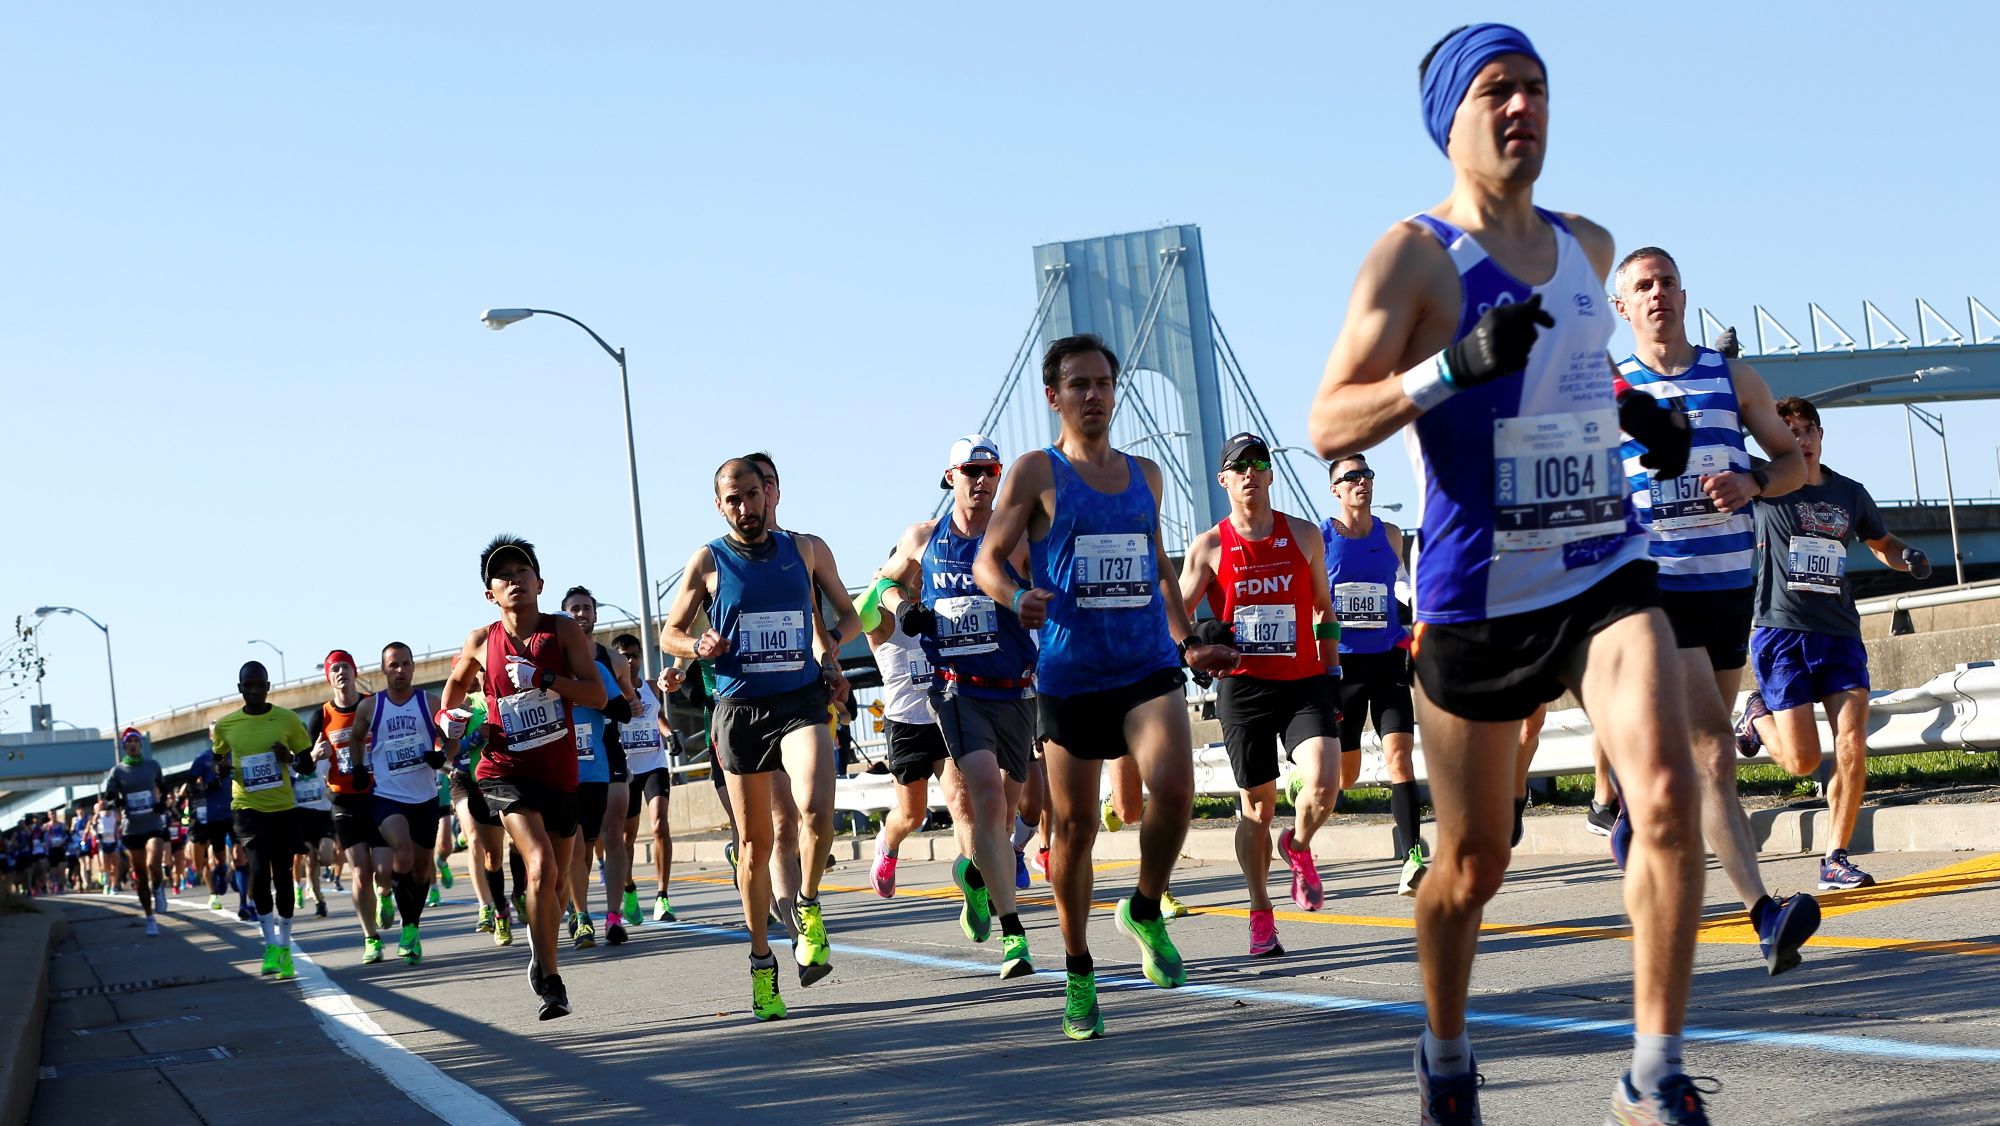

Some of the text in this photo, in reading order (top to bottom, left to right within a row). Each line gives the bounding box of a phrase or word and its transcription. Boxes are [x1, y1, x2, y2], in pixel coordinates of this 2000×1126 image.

[1499, 462, 1513, 500] 2019
[1535, 454, 1595, 499] 1064
[1603, 504, 1613, 517] A
[1100, 558, 1132, 580] 1737
[1807, 555, 1829, 573] 1501
[932, 572, 981, 590] NYP
[1234, 574, 1293, 598] FDNY
[1349, 597, 1374, 611] 1648
[950, 614, 979, 634] 1249
[1254, 623, 1279, 641] 1137
[760, 630, 787, 650] 1140
[386, 715, 416, 734] WARWICK
[503, 715, 512, 734] 2019
[519, 706, 547, 729] 1109
[632, 730, 650, 741] 1525
[396, 746, 416, 761] 1685
[252, 763, 272, 777] 1566
